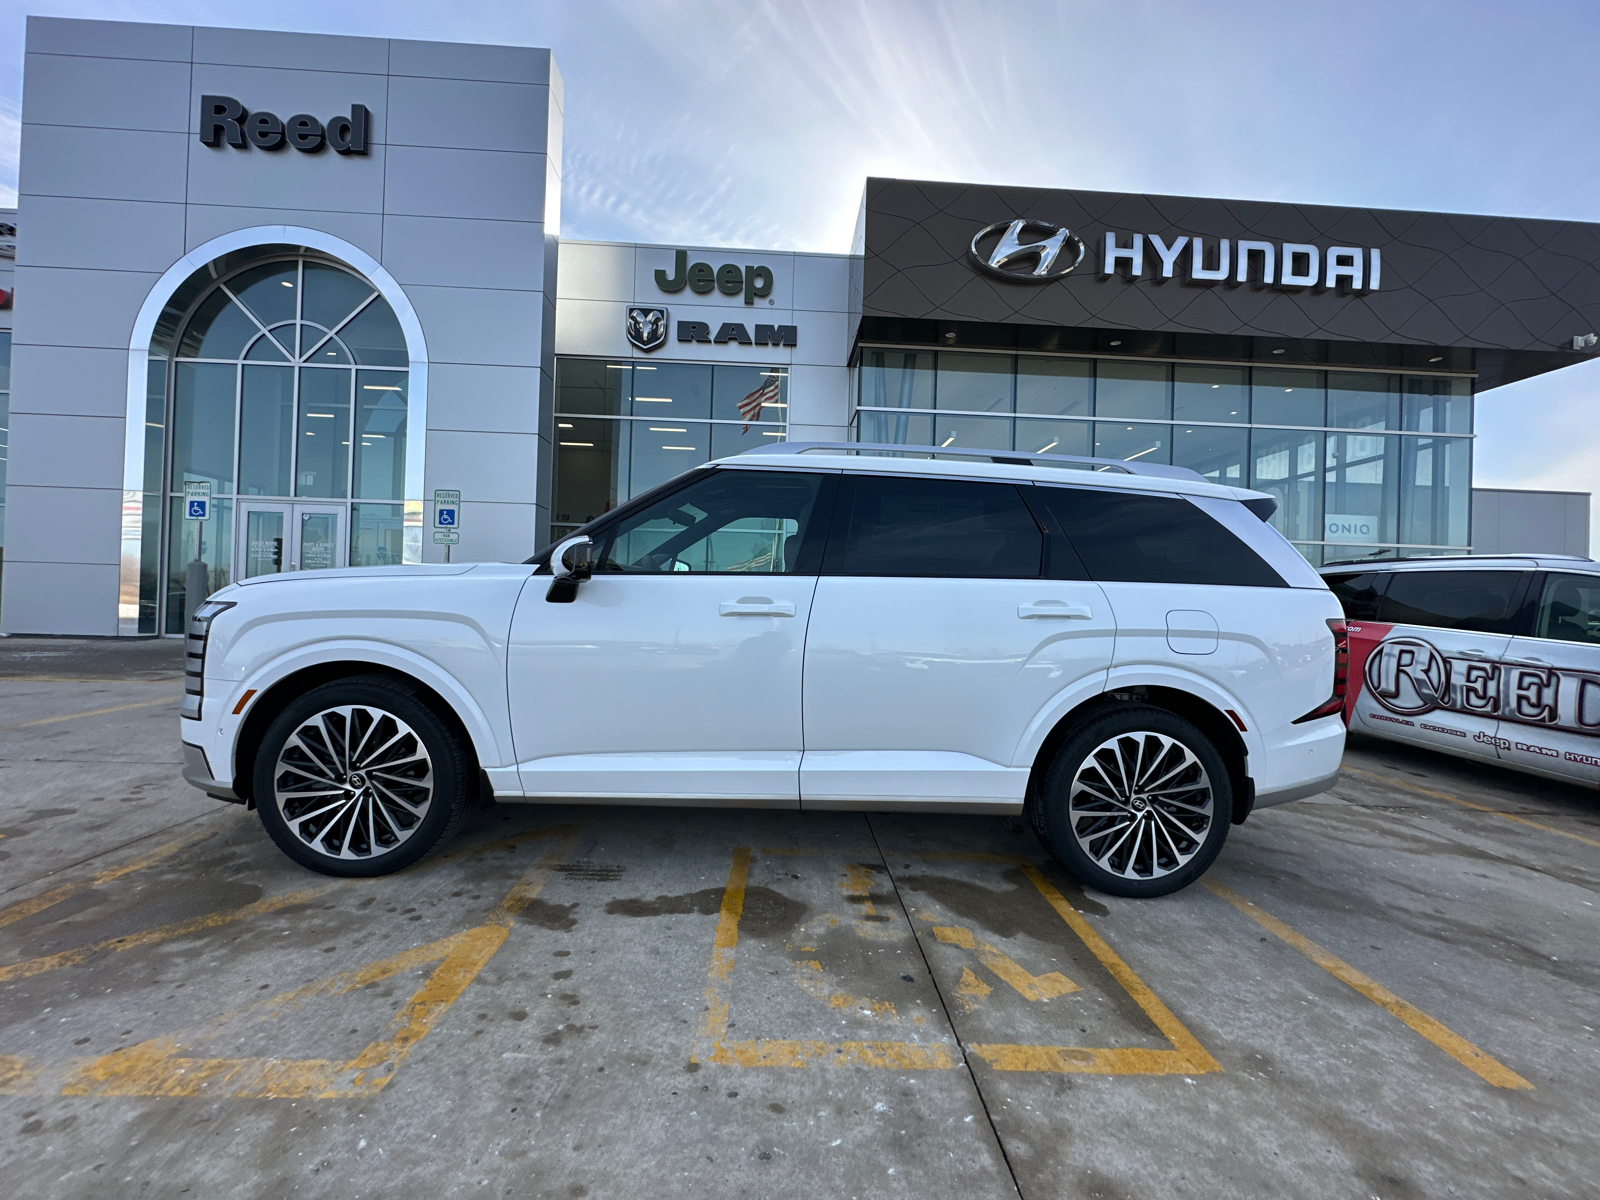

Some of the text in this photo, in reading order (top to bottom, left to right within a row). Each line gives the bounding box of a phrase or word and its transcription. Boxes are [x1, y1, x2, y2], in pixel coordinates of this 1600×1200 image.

[200, 95, 368, 155] Reed
[655, 250, 774, 304] Jeep
[1103, 231, 1381, 291] HYUNDAI
[677, 320, 798, 346] RAM
[1326, 522, 1370, 535] ONIQ
[1369, 713, 1415, 726] CHRYSLER
[1420, 723, 1467, 737] DODGE
[1473, 731, 1510, 750] Jeep
[1516, 742, 1559, 758] RAM
